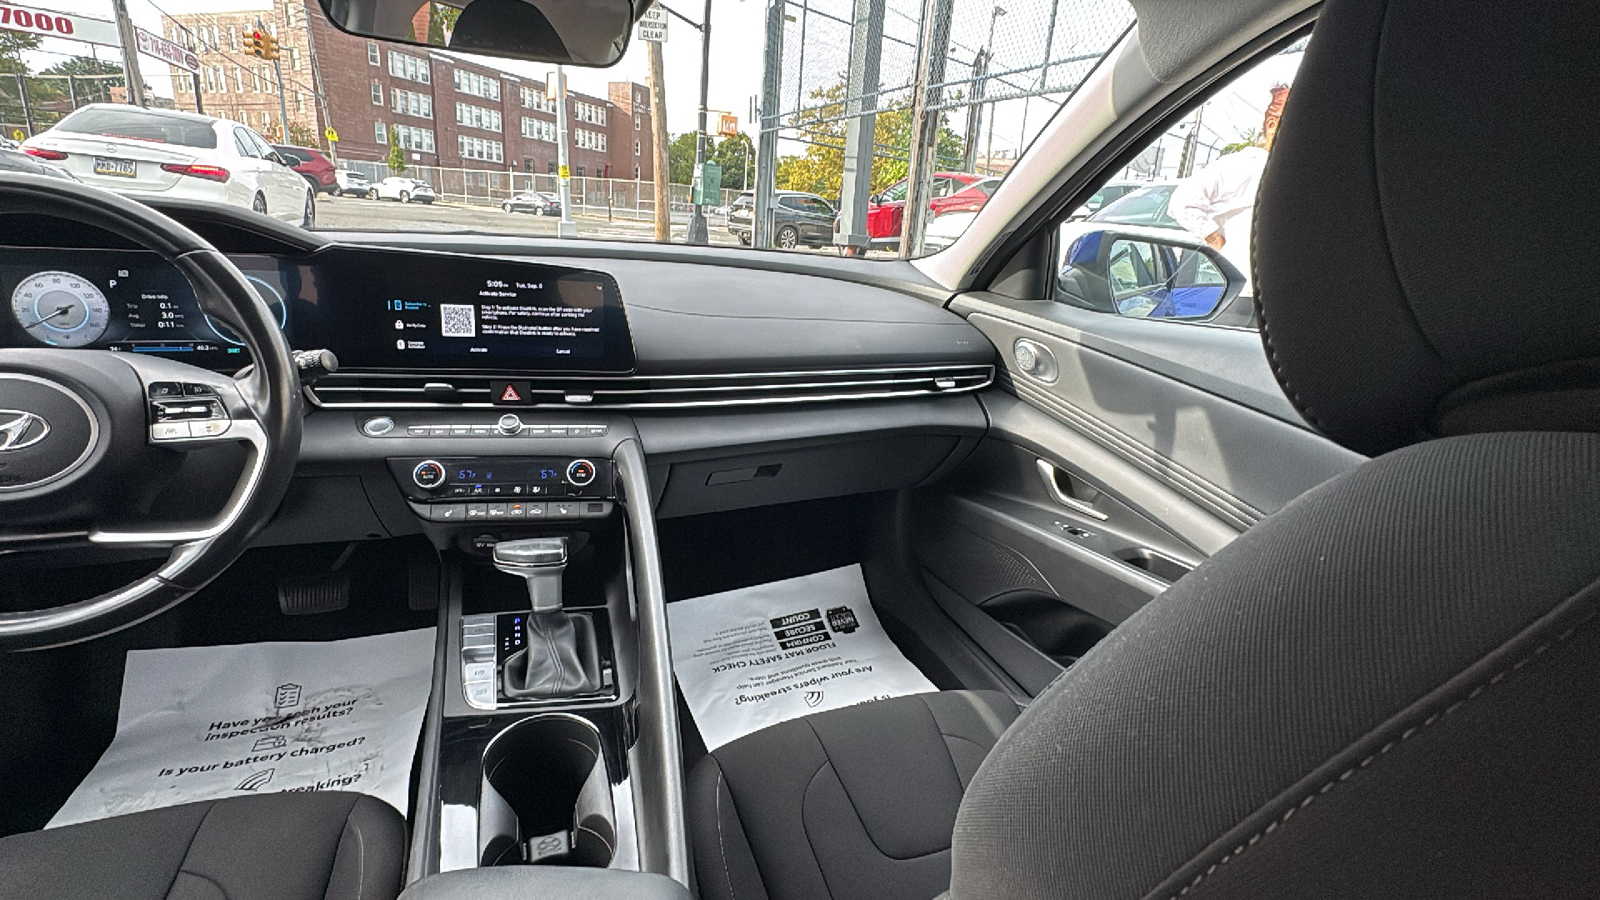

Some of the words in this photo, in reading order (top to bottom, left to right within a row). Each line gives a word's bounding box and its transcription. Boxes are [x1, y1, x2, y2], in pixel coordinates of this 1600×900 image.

[0, 6, 74, 34] 7000
[642, 30, 663, 39] CLEAR
[109, 280, 117, 288] P
[781, 612, 810, 625] COUNT
[784, 624, 815, 637] SECURE
[786, 634, 824, 647] CONFIRM
[785, 648, 805, 659] MAT
[805, 642, 836, 653] FLOOR
[712, 661, 746, 673] CHECK
[750, 655, 783, 666] SAFETY
[831, 668, 854, 678] your
[793, 676, 830, 688] wipers
[735, 685, 792, 705] streaking?
[208, 718, 250, 731] Have
[324, 699, 359, 712] your
[294, 707, 354, 726] results?
[158, 768, 173, 777] Is
[175, 762, 221, 777] your
[222, 750, 287, 769] battery
[289, 736, 366, 758] charged?
[282, 774, 362, 792] reaking?
